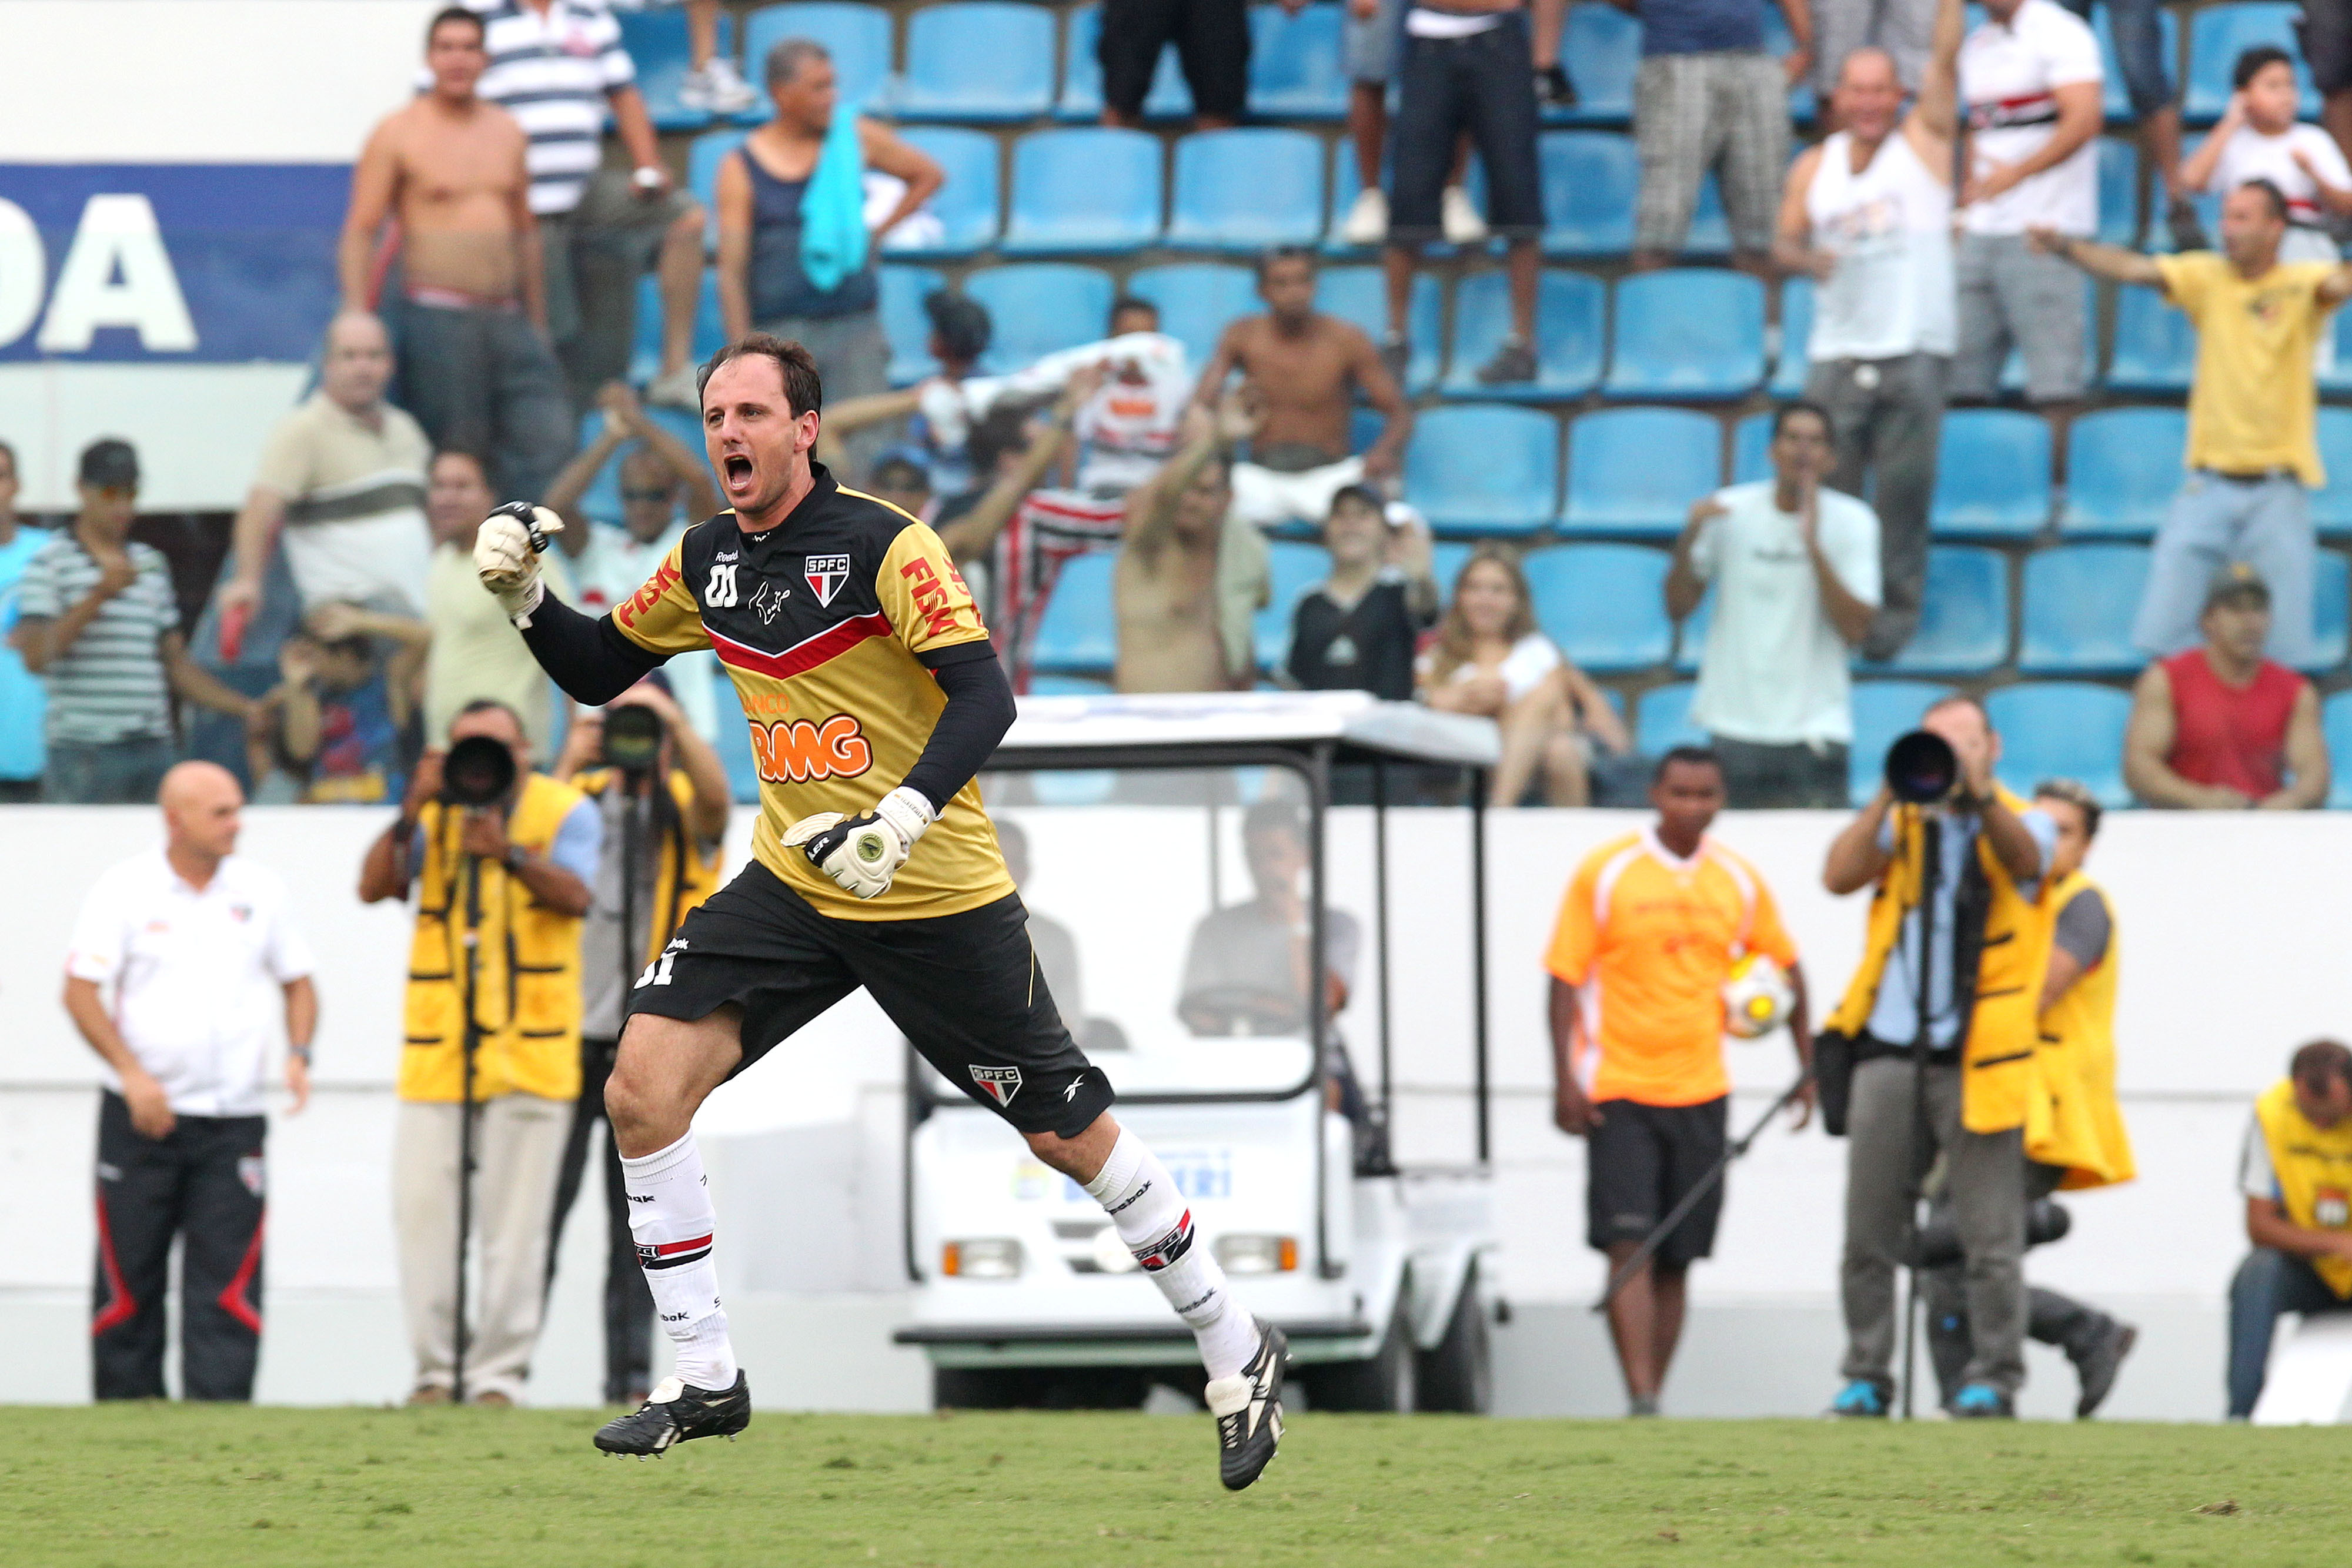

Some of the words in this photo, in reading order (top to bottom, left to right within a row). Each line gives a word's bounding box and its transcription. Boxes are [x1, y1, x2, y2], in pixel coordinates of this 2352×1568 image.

[704, 564, 739, 607] 01
[808, 559, 846, 571] SPFC
[900, 557, 958, 638] FISK
[739, 693, 790, 714] ANCO
[749, 714, 872, 784] BMG
